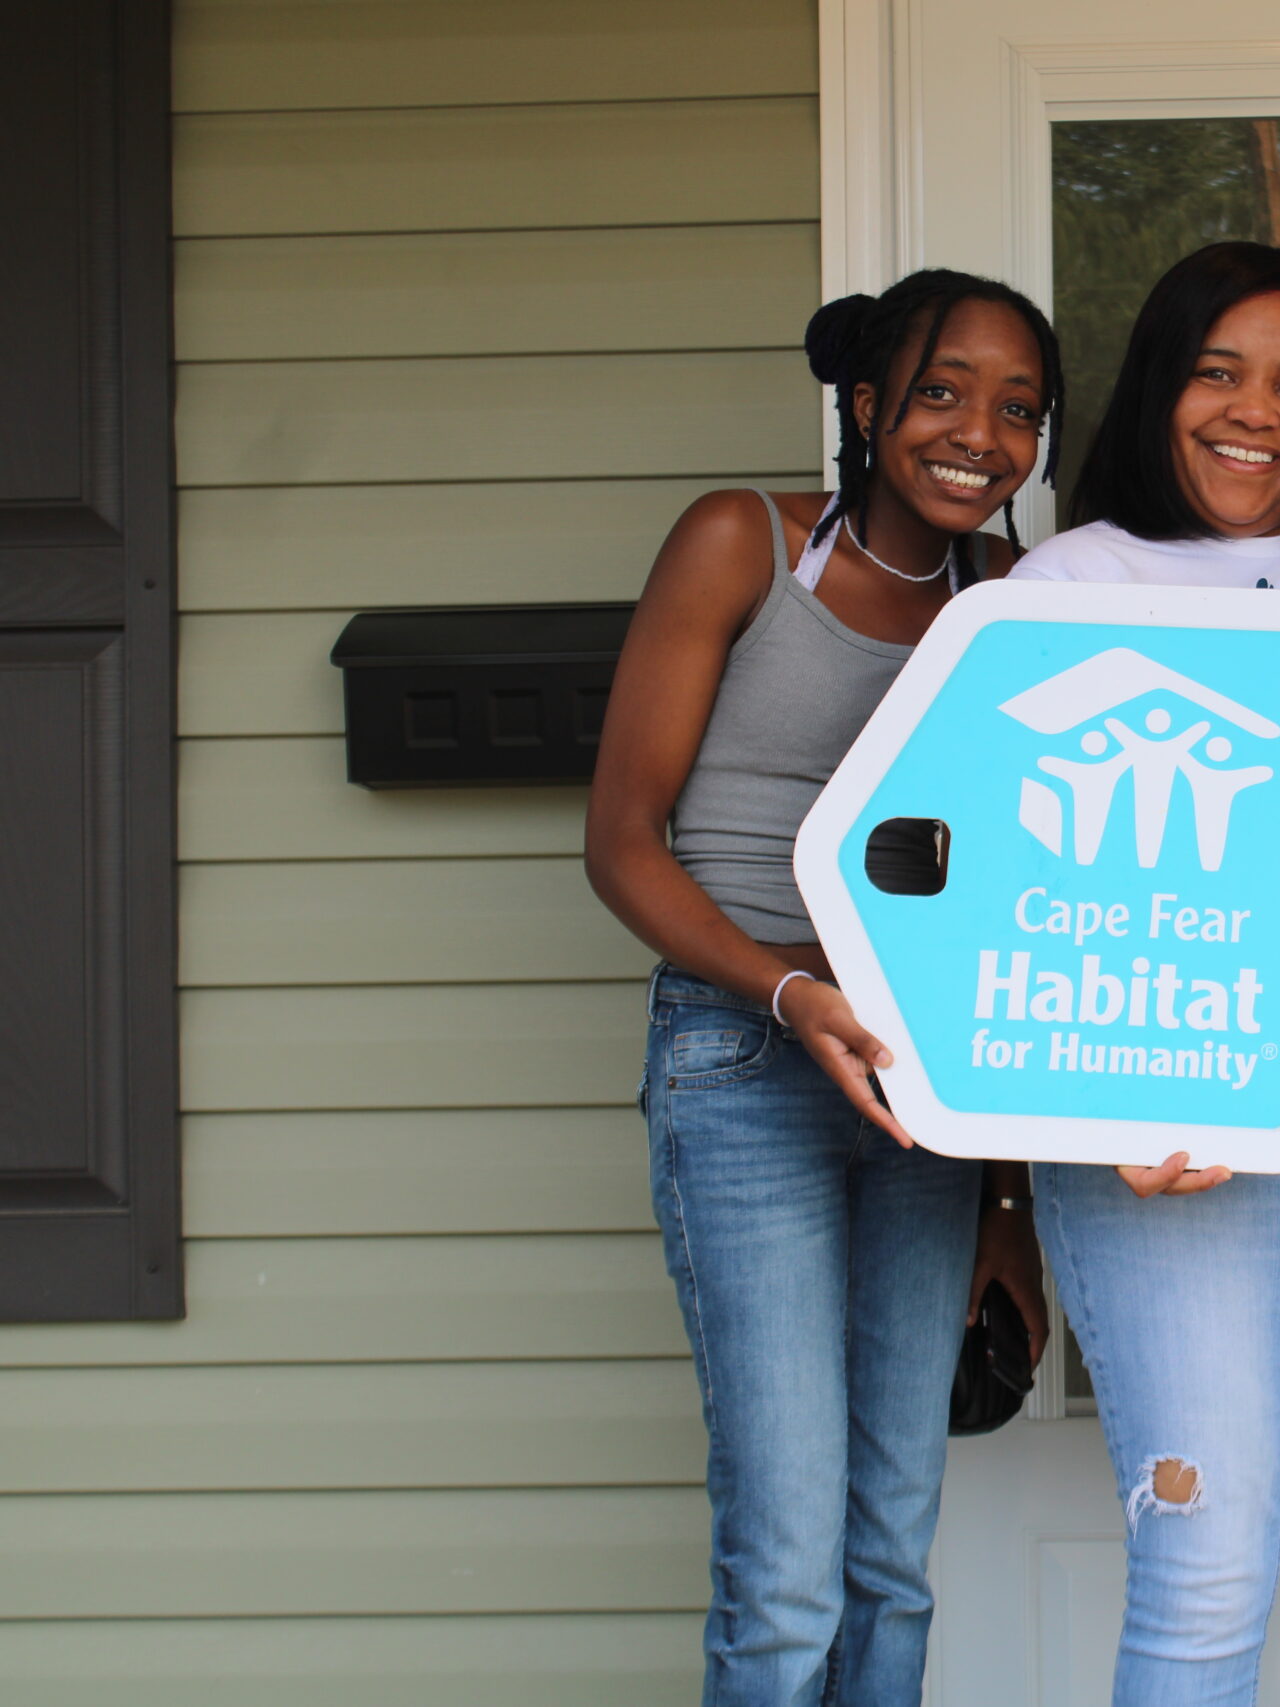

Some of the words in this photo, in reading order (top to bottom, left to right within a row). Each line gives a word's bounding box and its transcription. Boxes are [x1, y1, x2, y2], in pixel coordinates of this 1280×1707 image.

[1014, 886, 1130, 945] Cape
[1148, 893, 1251, 943] Fear
[974, 950, 1263, 1034] Habitat
[971, 1029, 1032, 1069] for
